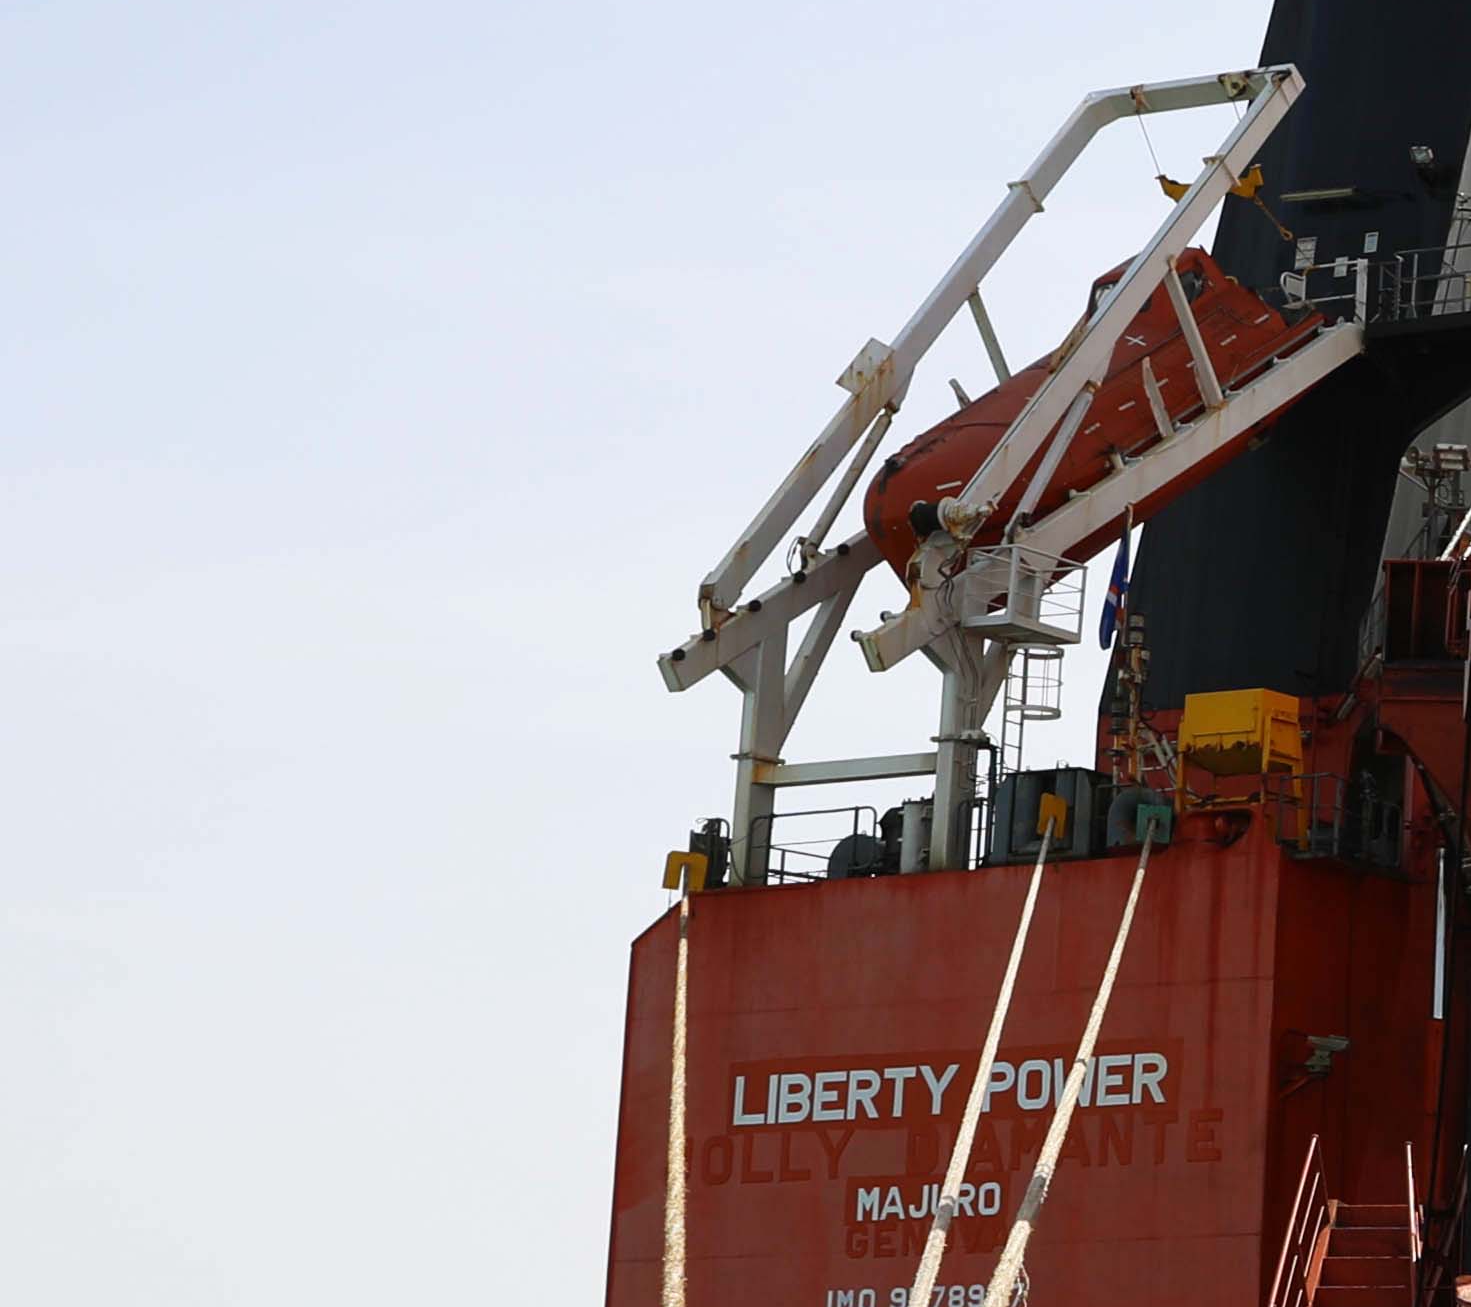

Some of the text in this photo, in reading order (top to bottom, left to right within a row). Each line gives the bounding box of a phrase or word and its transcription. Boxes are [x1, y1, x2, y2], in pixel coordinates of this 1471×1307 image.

[733, 1052, 1168, 1125] LIBERTY POWER
[906, 1108, 1224, 1175] DAMANTE
[846, 1223, 1004, 1259] GENVA
